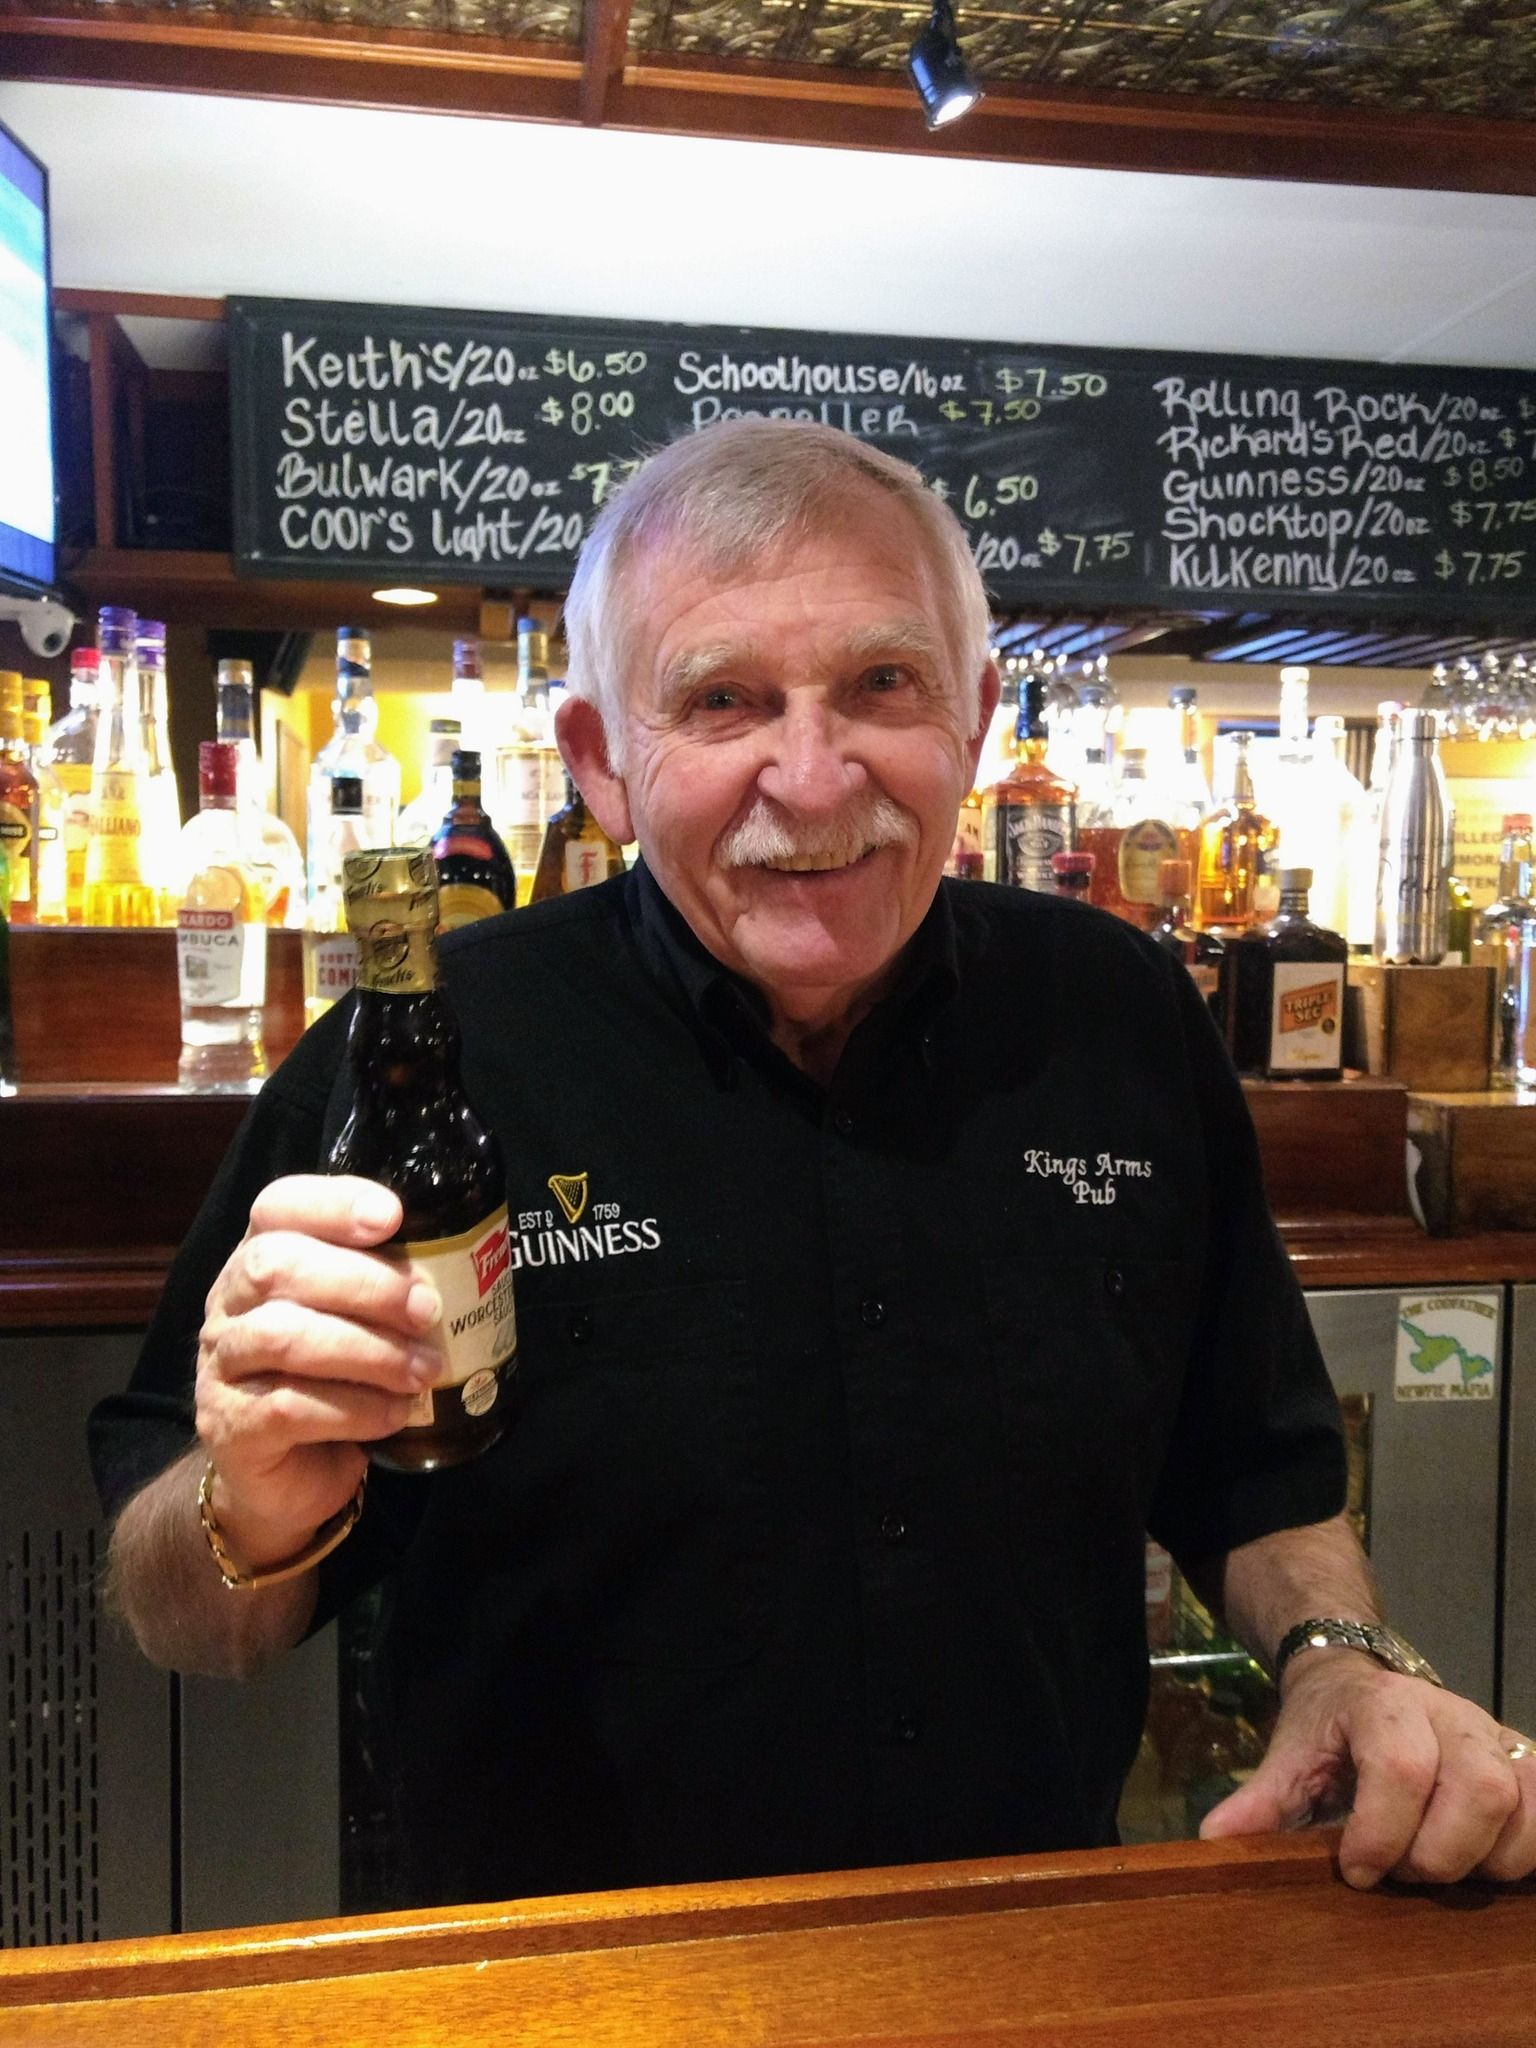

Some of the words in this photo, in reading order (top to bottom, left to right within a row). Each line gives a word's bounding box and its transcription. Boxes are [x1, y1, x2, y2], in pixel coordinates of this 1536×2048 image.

[542, 347, 648, 384] $6.50
[995, 367, 1108, 398] $7.50
[540, 391, 635, 436] $8.00
[938, 400, 1041, 426] $7.50
[1153, 376, 1300, 430] Rolling
[1156, 420, 1333, 471] Rickard's
[1443, 457, 1525, 492] $8.50
[1037, 527, 1135, 574] $7.75
[1434, 549, 1528, 586] $7.75
[1023, 1149, 1088, 1186] Kings
[1094, 1152, 1153, 1178] Arms
[1072, 1178, 1117, 1205] Pub
[592, 1202, 621, 1221] 1759
[508, 1217, 662, 1271] GUINNESS
